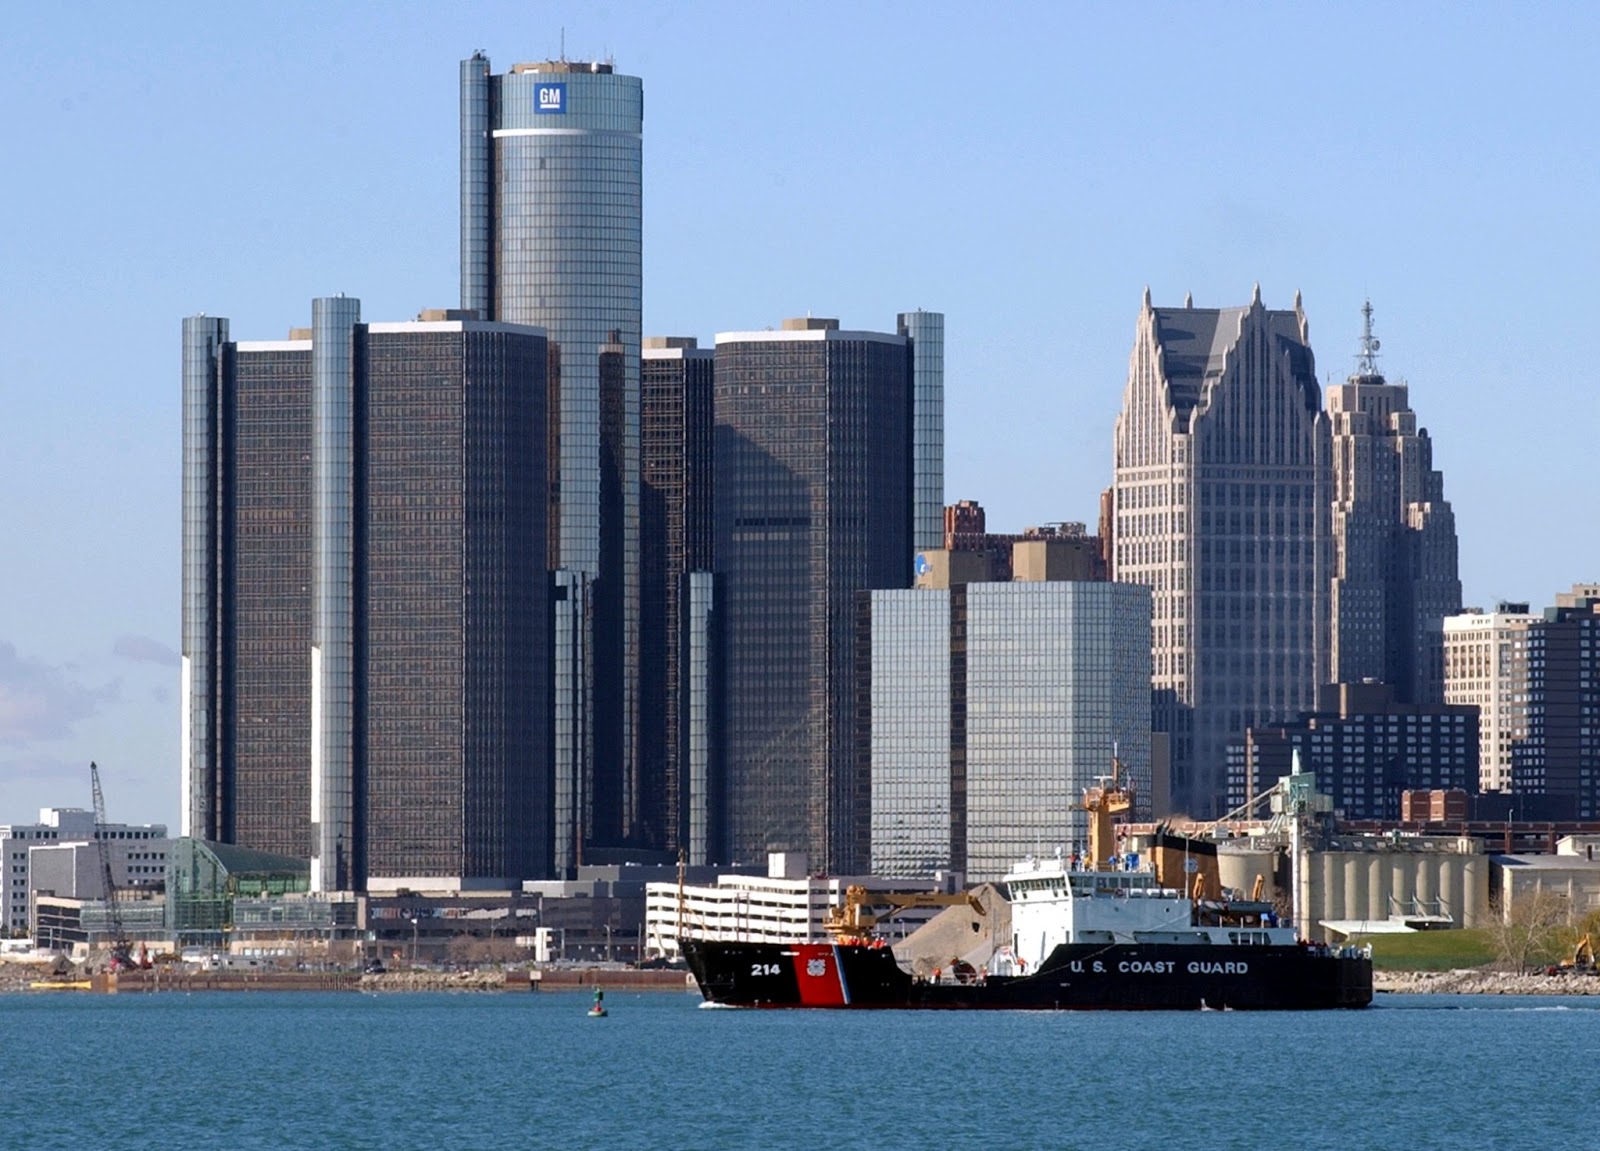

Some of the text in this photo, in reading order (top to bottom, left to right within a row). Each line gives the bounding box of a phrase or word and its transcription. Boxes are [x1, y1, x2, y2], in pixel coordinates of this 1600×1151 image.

[540, 88, 560, 103] GM
[751, 964, 781, 976] 214
[1071, 961, 1249, 974] U. S. COAST GUARD
